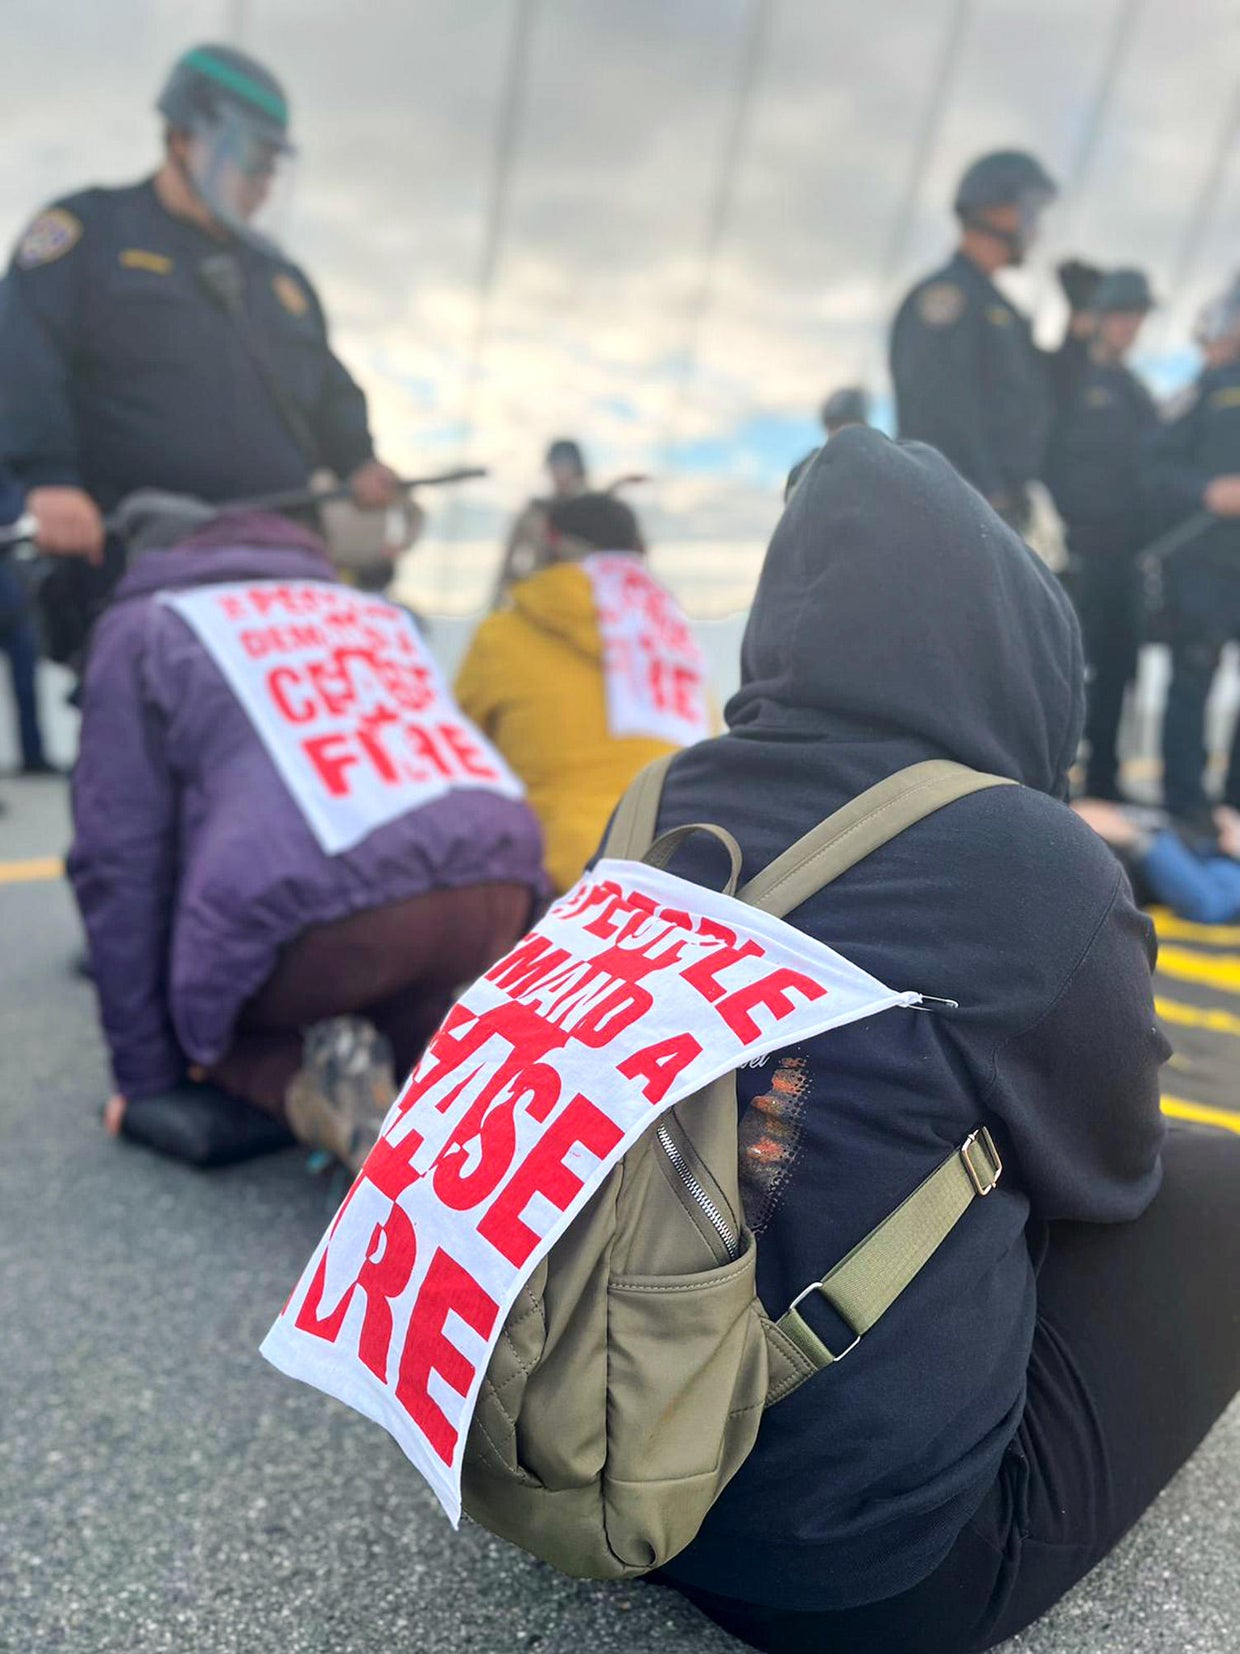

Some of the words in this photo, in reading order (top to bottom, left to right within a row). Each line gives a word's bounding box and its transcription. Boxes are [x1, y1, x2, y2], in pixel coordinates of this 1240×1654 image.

[383, 1002, 626, 1271] EASE
[484, 932, 654, 1049] MAND
[615, 1031, 704, 1105] A
[294, 1198, 501, 1468] RE
